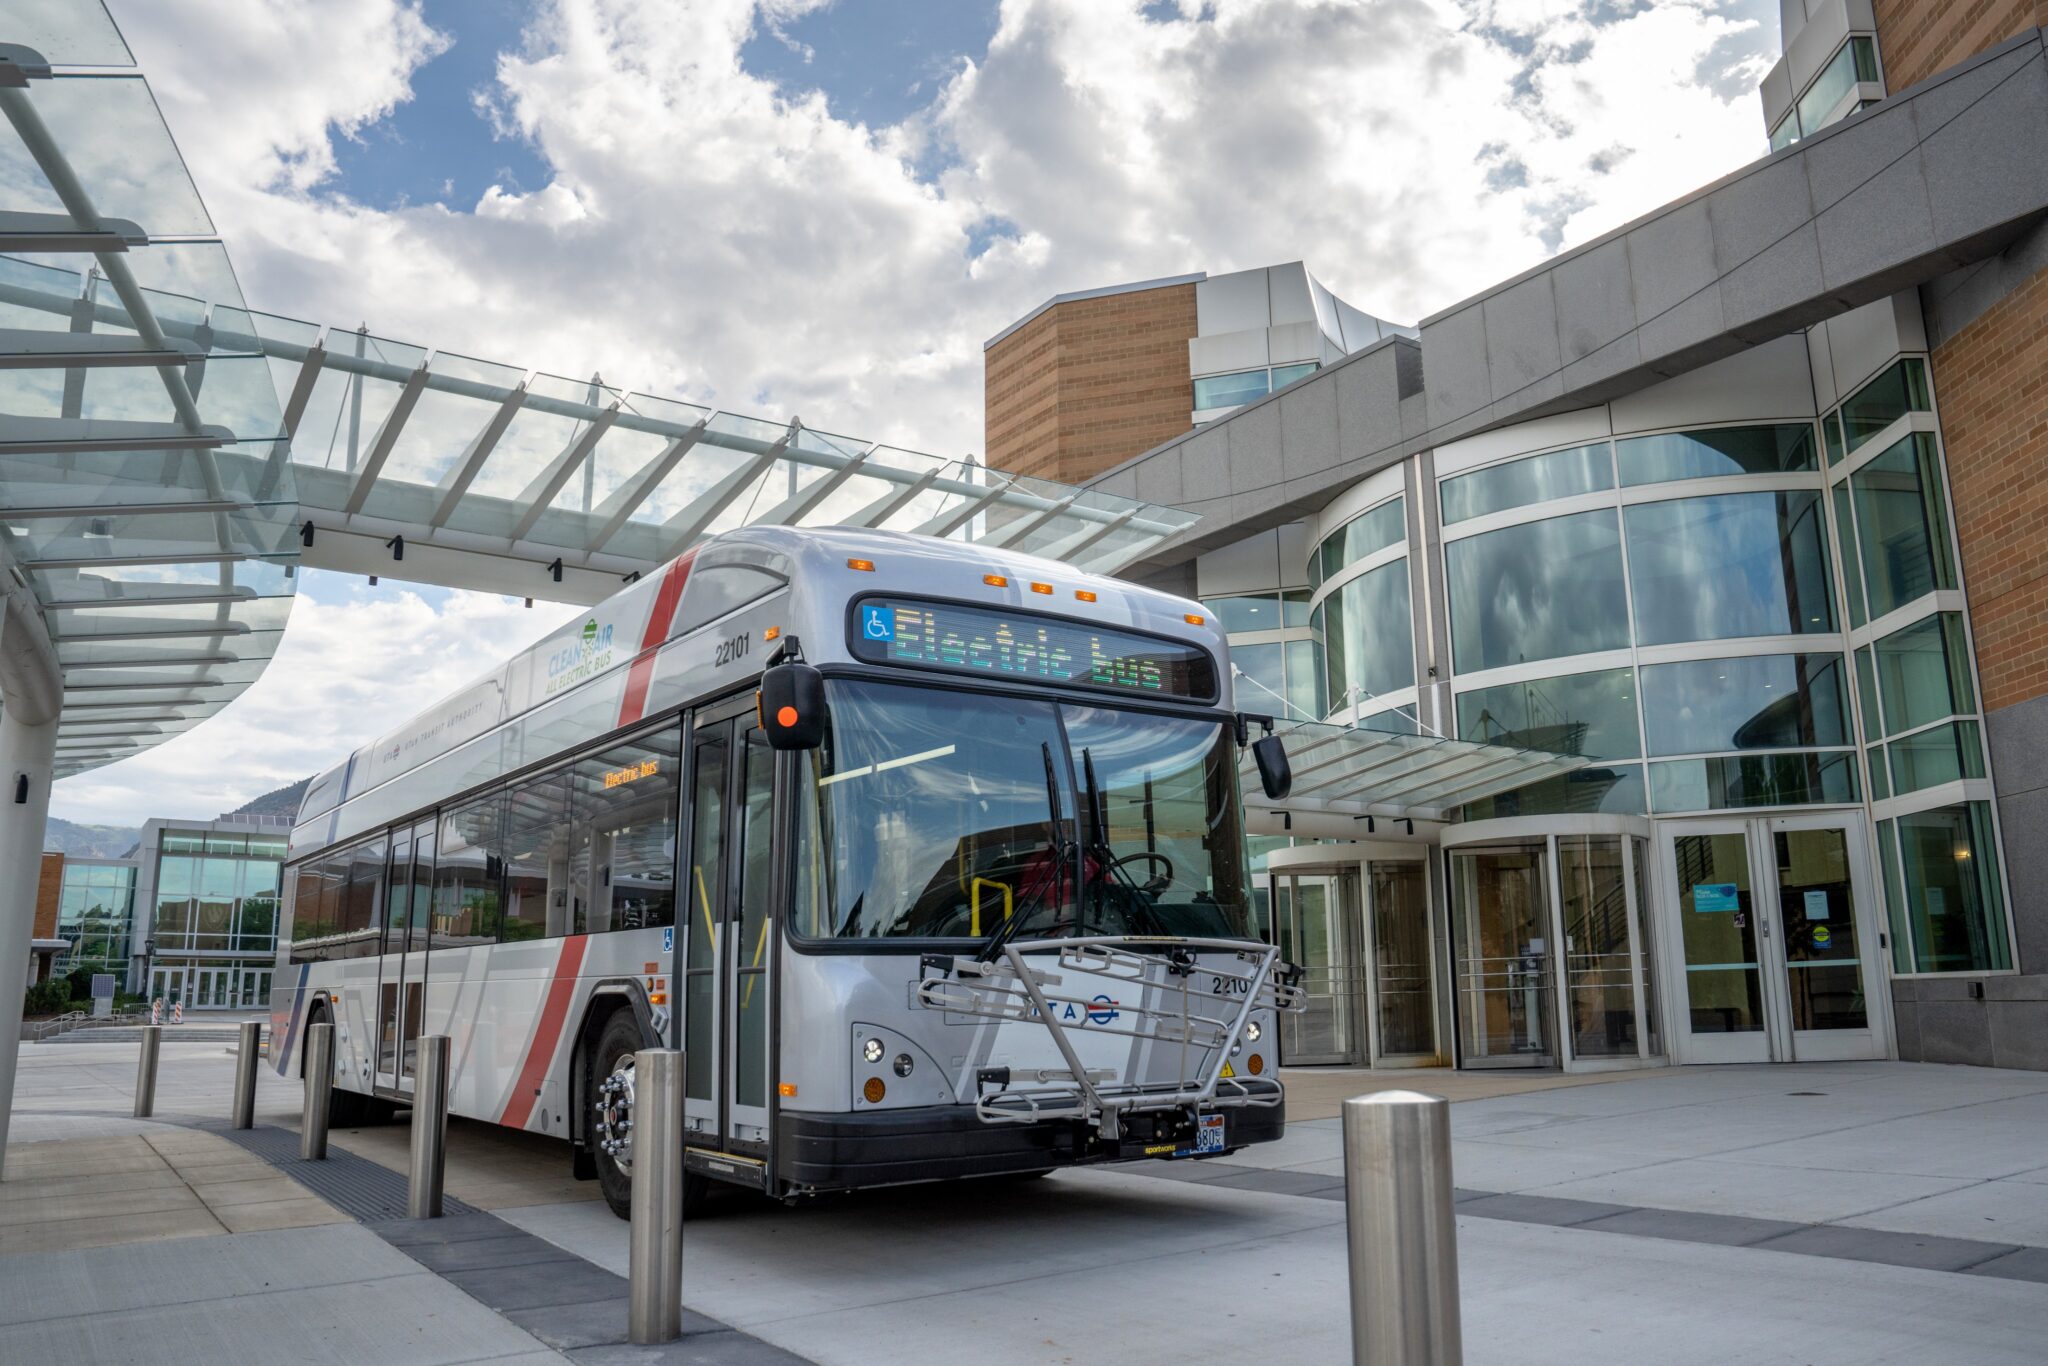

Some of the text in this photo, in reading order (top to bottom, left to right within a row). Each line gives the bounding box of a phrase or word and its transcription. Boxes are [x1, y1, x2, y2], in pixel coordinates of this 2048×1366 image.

[548, 624, 613, 678] CLEAN AIR
[715, 631, 749, 668] 22101
[896, 608, 1072, 678] Electric
[545, 649, 612, 694] ALL ELECTRIC BUS
[420, 723, 445, 742] TRANSIT
[447, 703, 483, 728] AUTHORITY
[605, 765, 639, 789] Electric
[1145, 1145, 1177, 1155] sportworks
